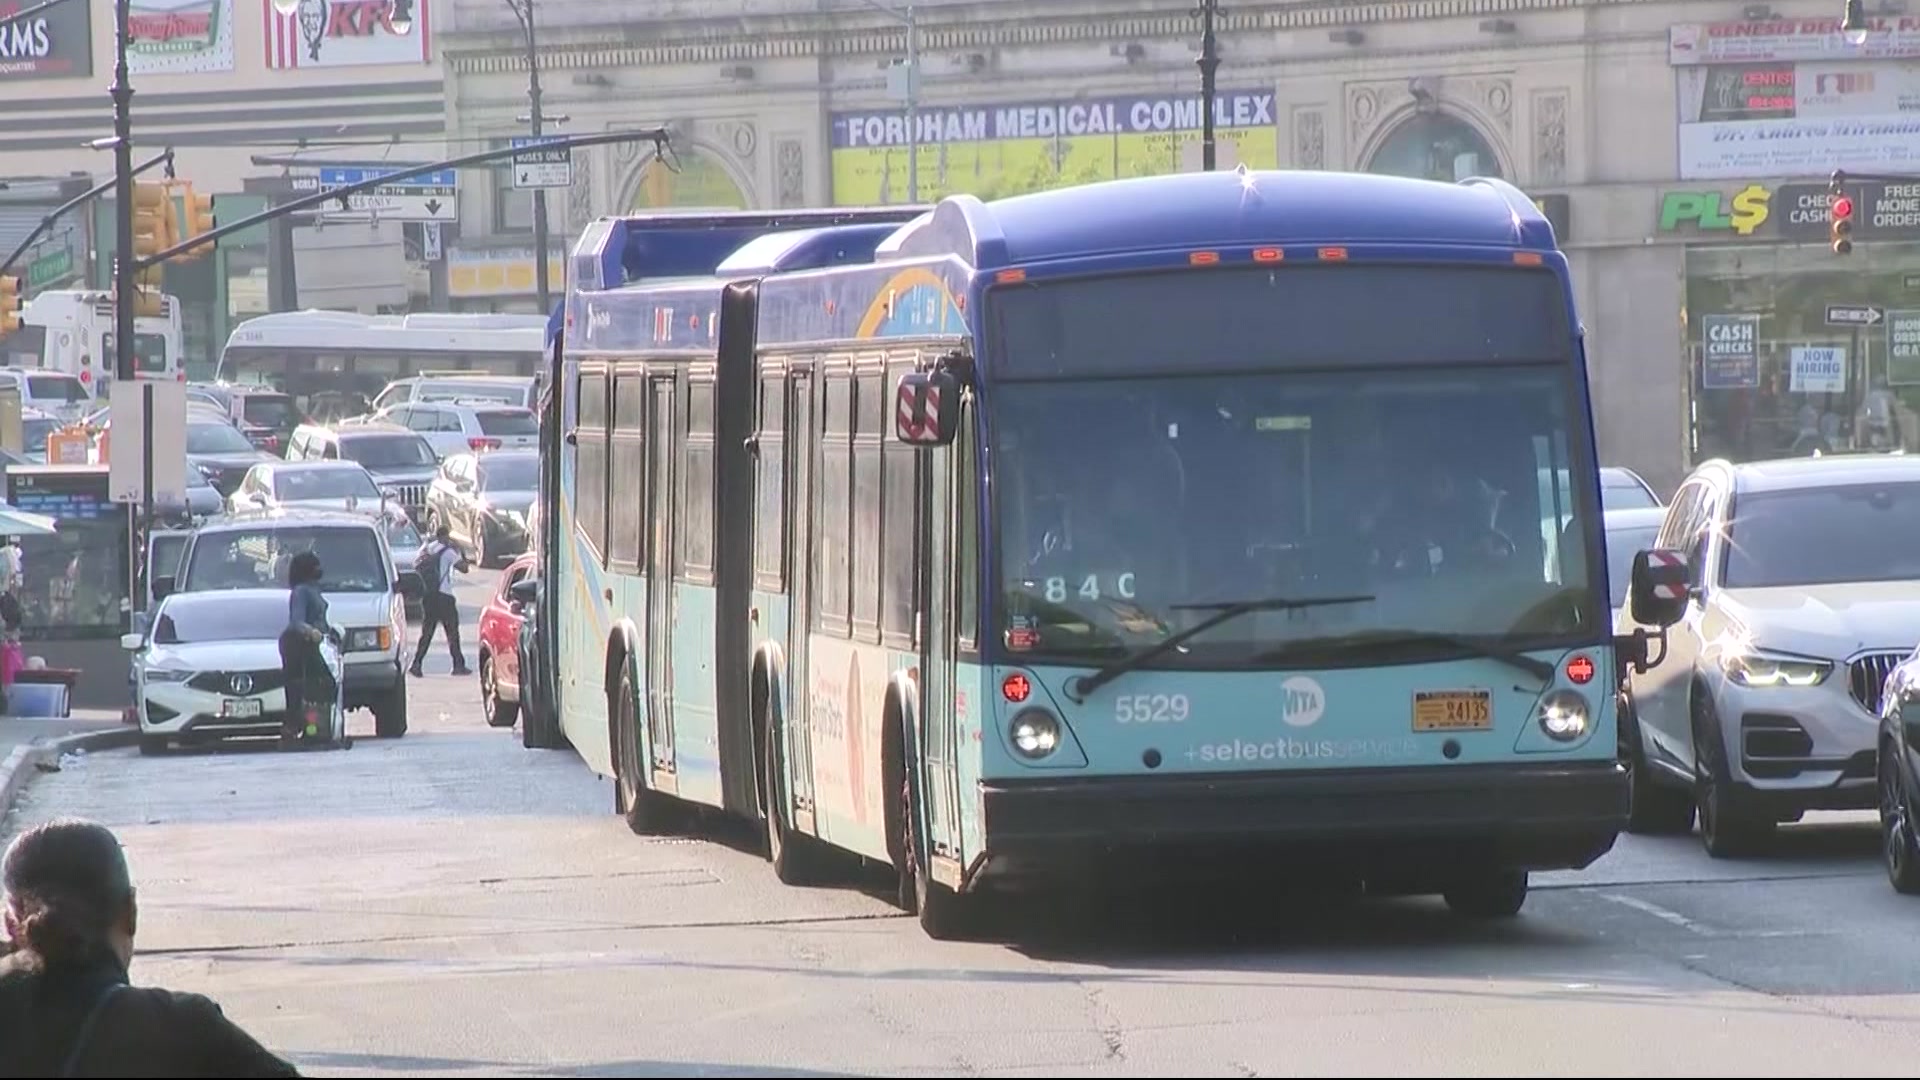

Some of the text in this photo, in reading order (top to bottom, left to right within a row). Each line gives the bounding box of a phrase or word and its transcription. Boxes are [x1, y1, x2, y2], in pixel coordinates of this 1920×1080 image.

[1708, 22, 1796, 38] GENESIS
[848, 110, 987, 147] FORDHAM
[996, 102, 1123, 138] MEDICAL
[1884, 185, 1920, 198] FREE
[1659, 185, 1772, 235] PL$
[1710, 324, 1752, 341] CASH
[1709, 341, 1753, 355] CHECKS
[1803, 350, 1834, 361] NOW
[1796, 361, 1841, 374] HIRING
[1115, 694, 1190, 723] 5529
